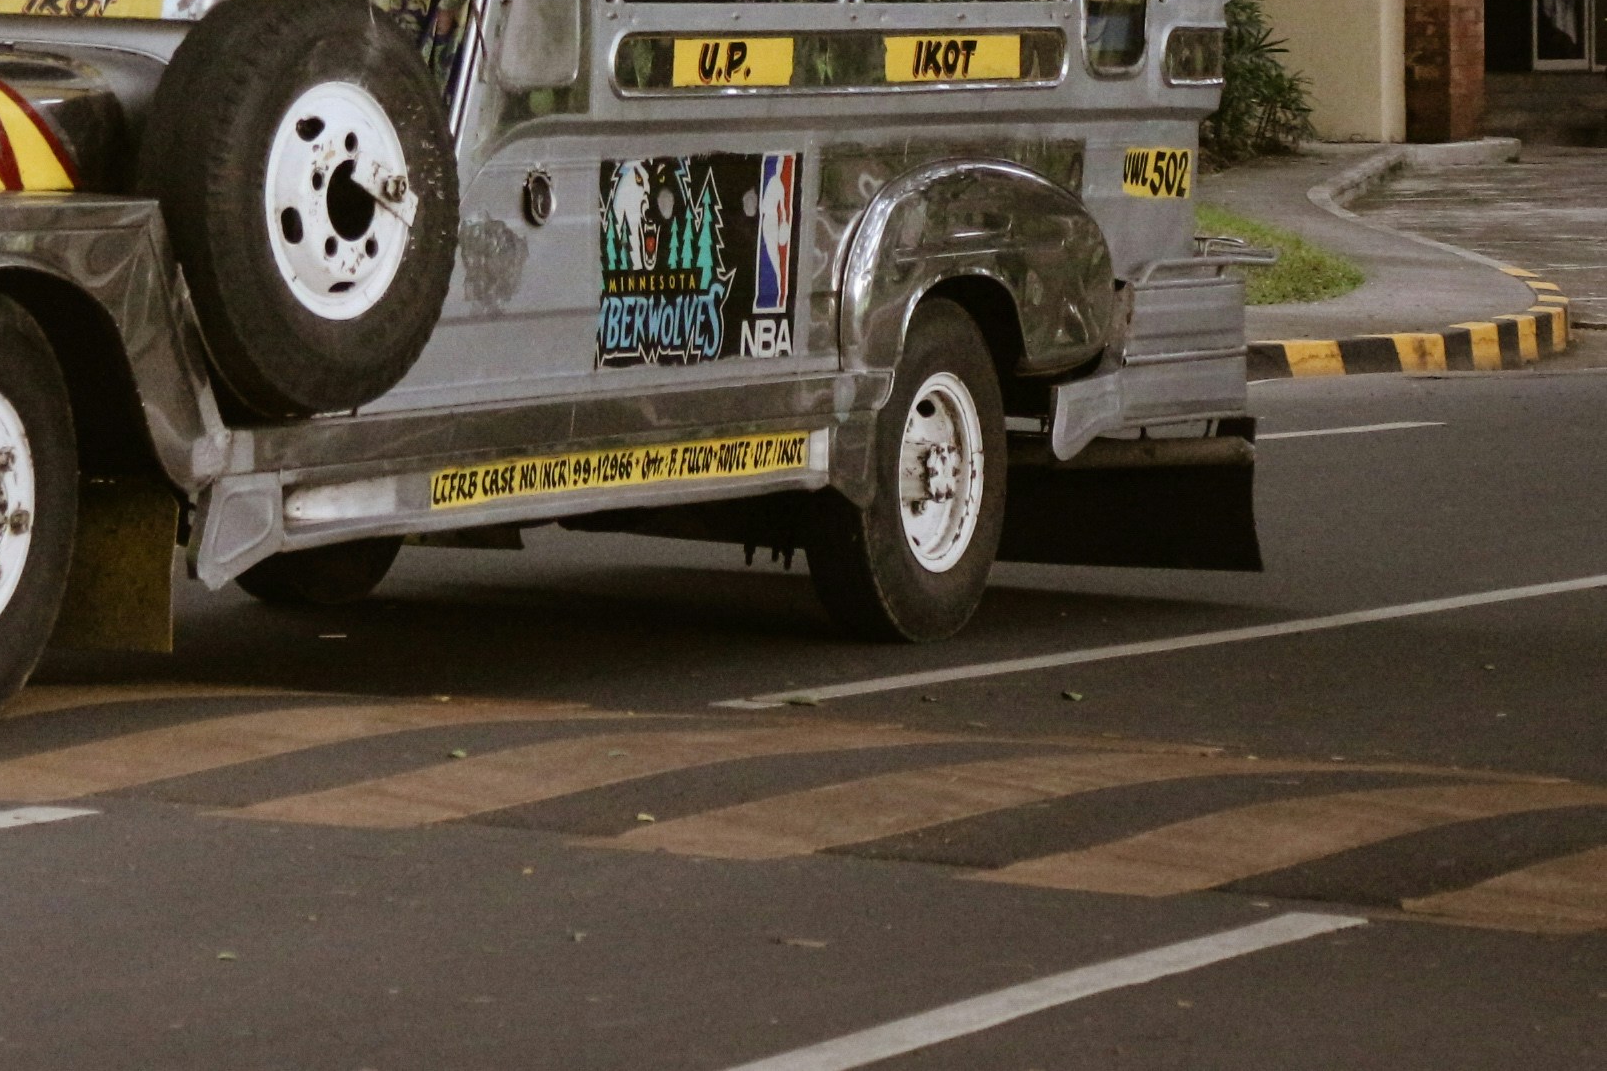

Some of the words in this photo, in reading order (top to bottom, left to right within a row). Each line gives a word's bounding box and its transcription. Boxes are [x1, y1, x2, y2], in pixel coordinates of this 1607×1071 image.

[698, 41, 751, 85] U.P.
[912, 39, 978, 79] IKOT
[1123, 151, 1149, 187] UWL
[1149, 151, 1189, 197] 502
[608, 273, 696, 294] MINNESOTA
[740, 318, 793, 358] NBA
[432, 470, 479, 505] LTFRB
[481, 463, 517, 497] CASE
